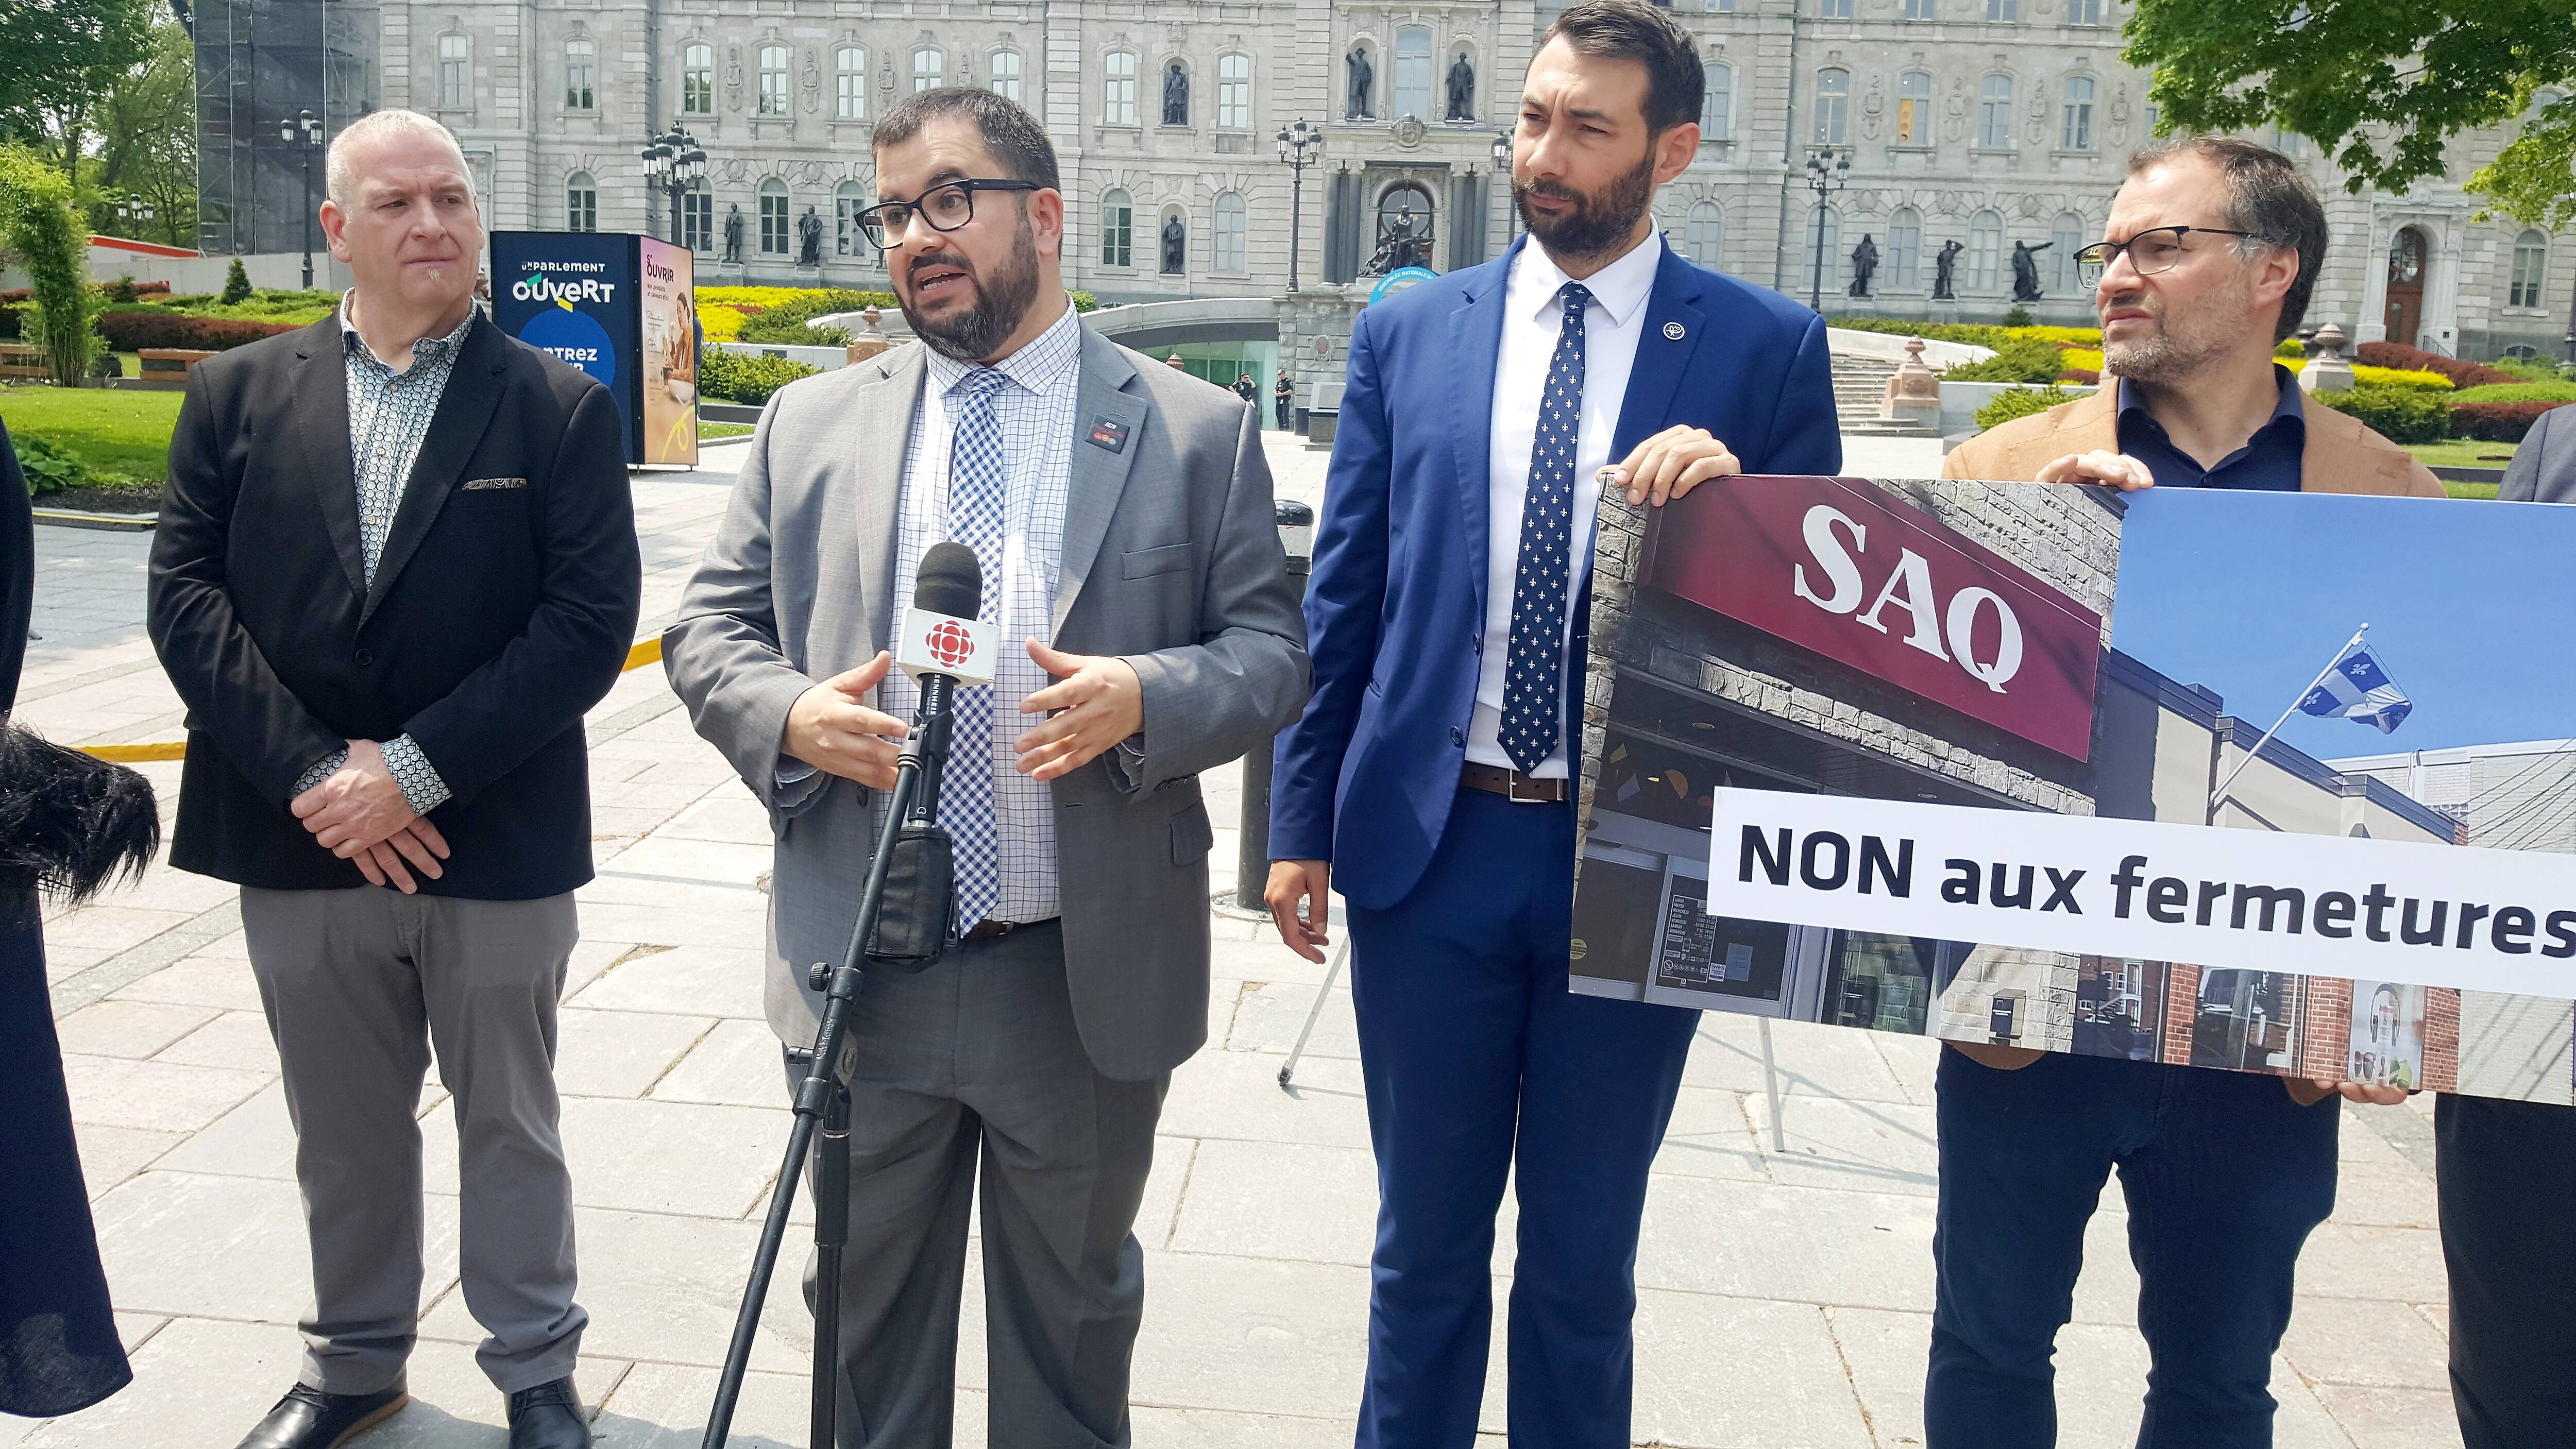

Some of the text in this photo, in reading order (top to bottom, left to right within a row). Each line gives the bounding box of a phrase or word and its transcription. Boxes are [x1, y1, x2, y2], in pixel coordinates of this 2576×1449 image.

[521, 261, 533, 271] UN
[647, 263, 674, 283] OUVRIR
[1378, 272, 1401, 292] ASSEMBLÉE
[1793, 504, 2024, 694] SAQ
[930, 674, 940, 715] SENNHEIS
[1739, 824, 2576, 958] NON aux fermetures
